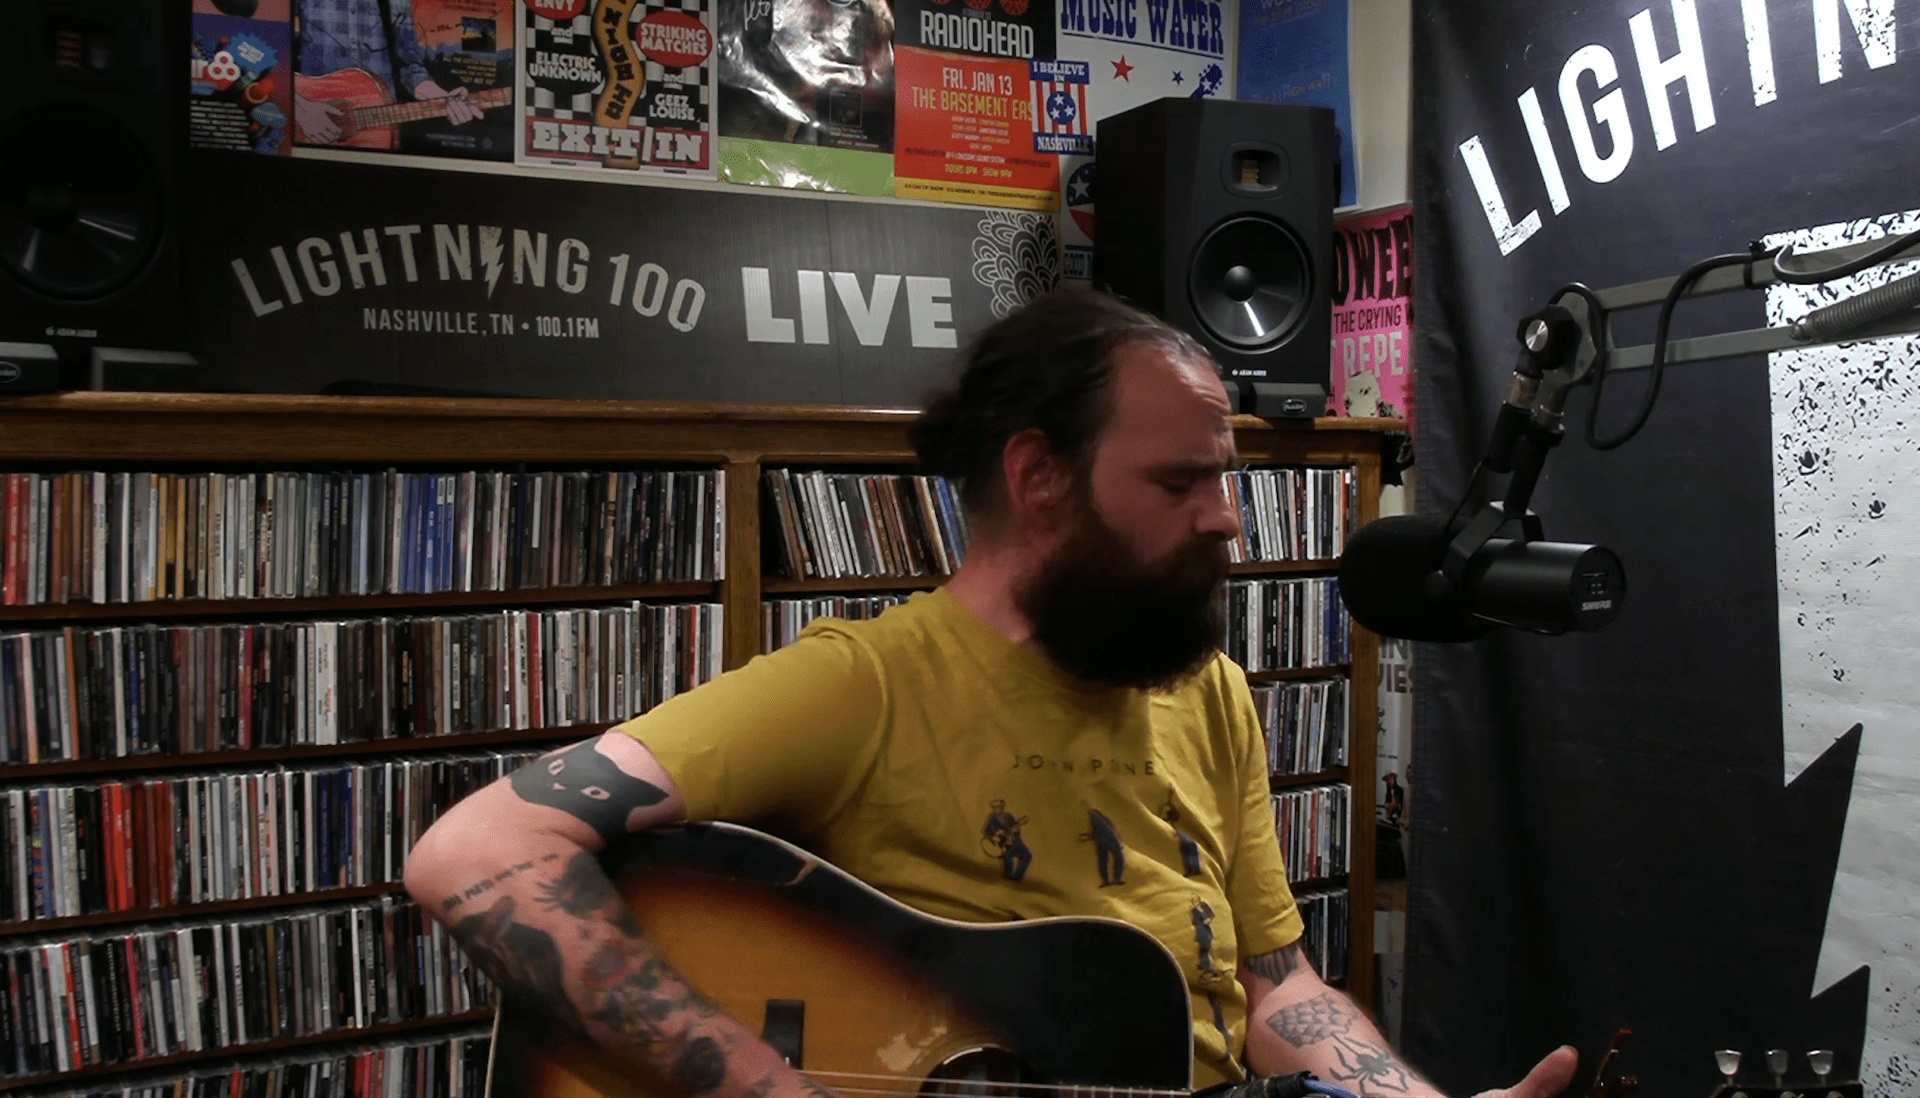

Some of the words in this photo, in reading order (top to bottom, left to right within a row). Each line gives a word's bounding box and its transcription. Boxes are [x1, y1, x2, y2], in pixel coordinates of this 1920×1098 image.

[641, 22, 707, 41] STRIKING
[920, 10, 1034, 59] RADIOHEAD
[1061, 0, 1137, 39] MUSIC
[1146, 0, 1224, 54] WATER
[641, 36, 708, 56] MATCHES
[535, 51, 596, 70] ELECTRIC
[1033, 61, 1038, 73] I
[1040, 62, 1085, 76] BELIEVE
[530, 64, 602, 83] UNKNOWN
[943, 67, 967, 90] FRI.
[971, 71, 995, 93] JAN
[998, 75, 1013, 96] 13
[1054, 74, 1065, 82] IN
[655, 93, 689, 109] GEEZ
[911, 86, 936, 109] THE
[941, 89, 1009, 118] BASEMENT
[650, 105, 695, 121] LOUISE
[1037, 136, 1089, 152] NASHVILLE
[608, 252, 707, 333] 100
[741, 266, 958, 348] LIVE
[1334, 311, 1355, 334] THE
[1358, 305, 1402, 331] CRYING
[1581, 600, 1612, 611] SHURE
